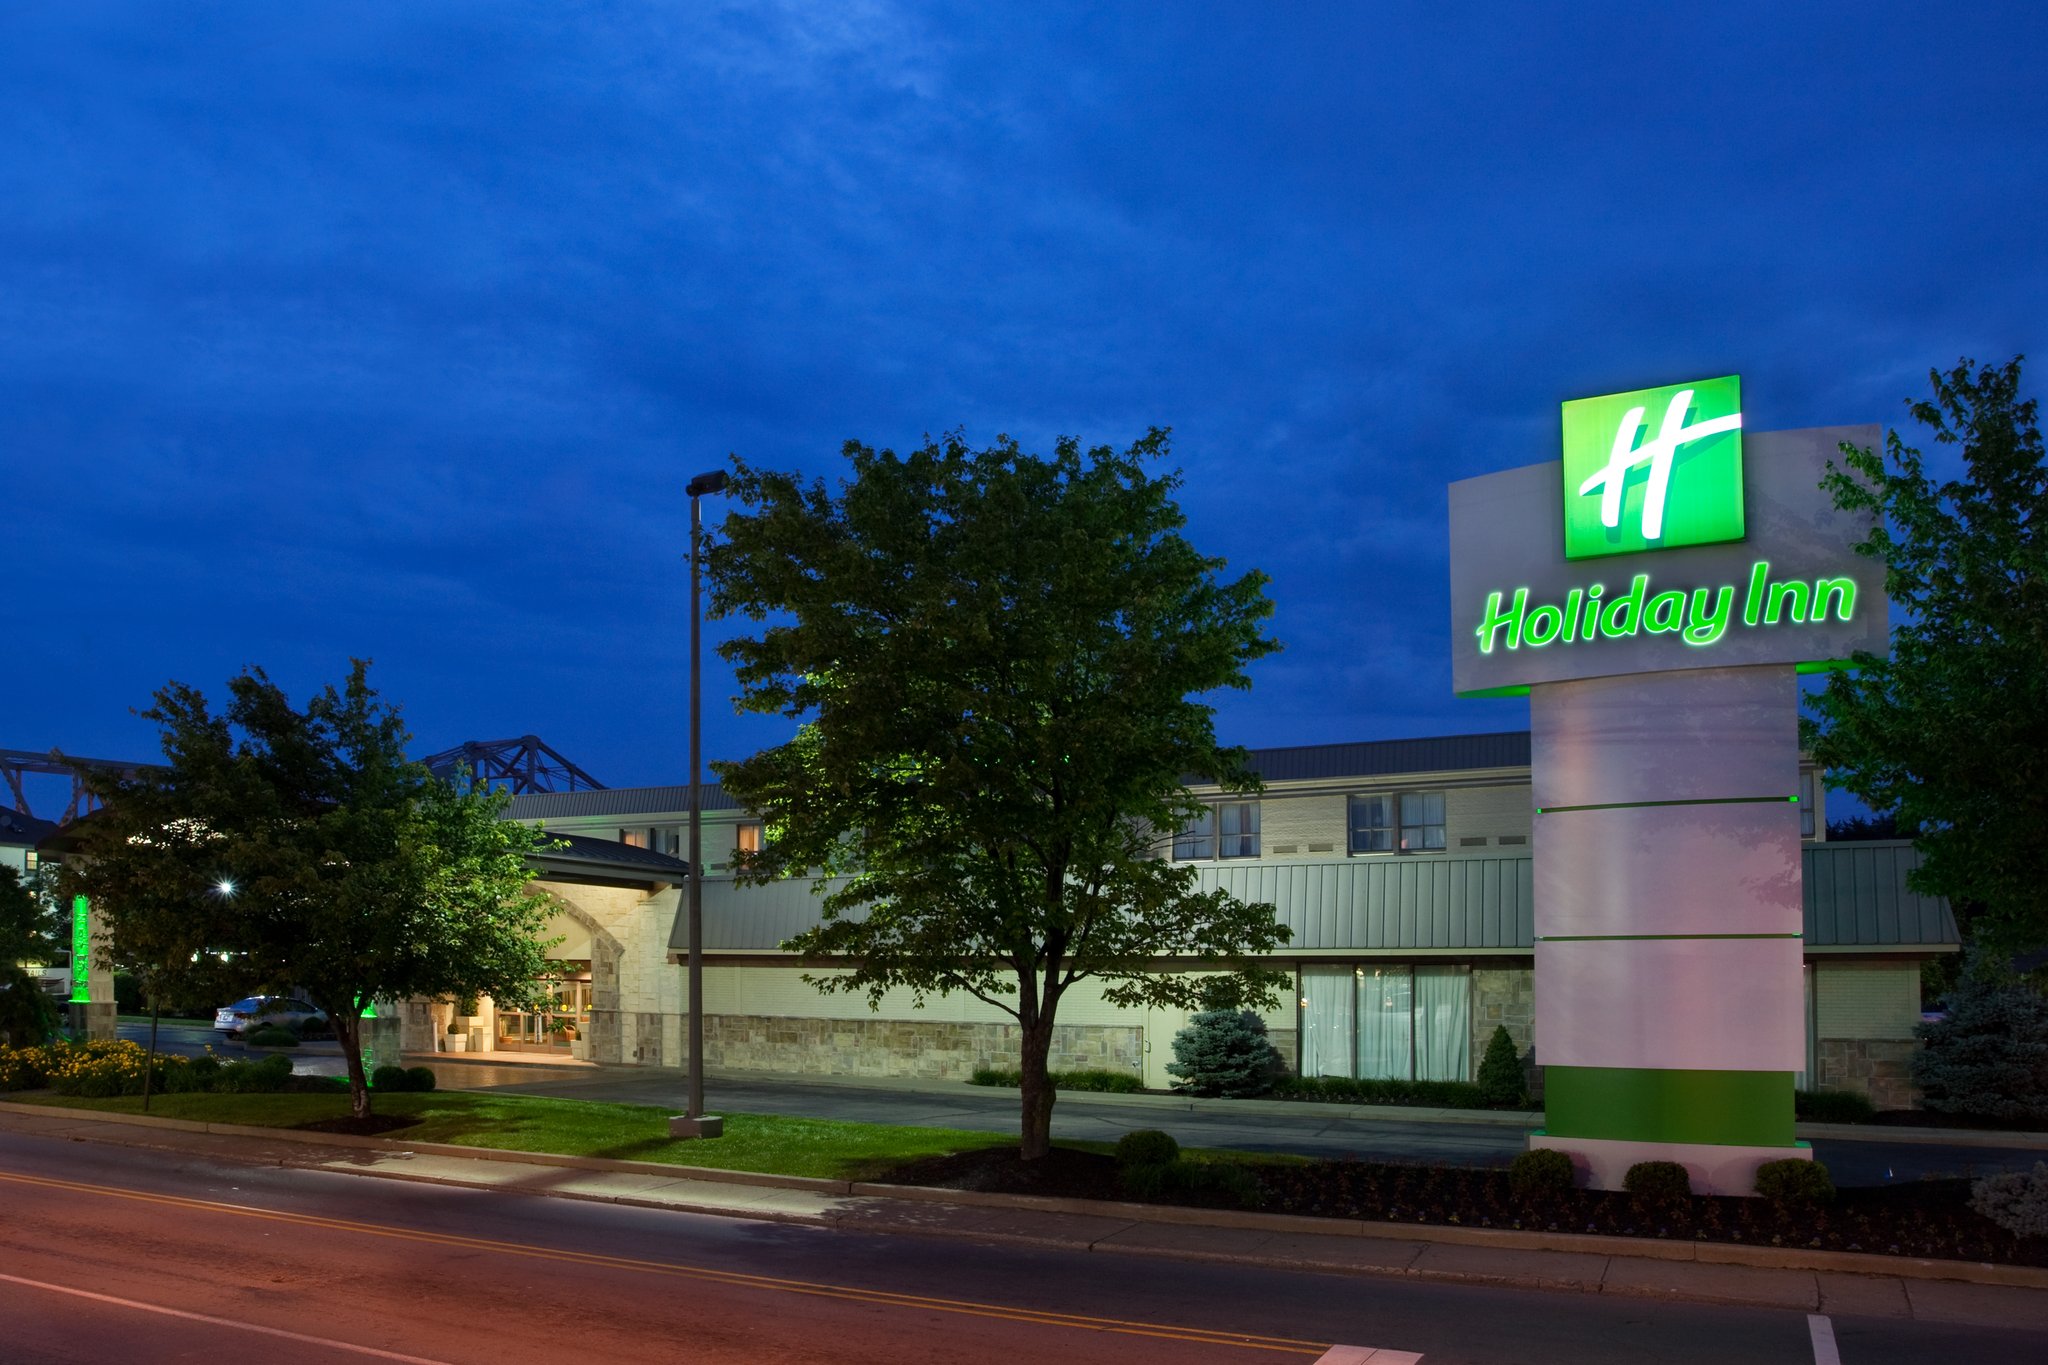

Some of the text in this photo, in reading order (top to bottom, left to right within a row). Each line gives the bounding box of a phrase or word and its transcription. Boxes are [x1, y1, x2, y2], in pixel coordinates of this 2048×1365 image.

[1579, 389, 1743, 540] H
[1476, 561, 1857, 654] Holiday Inn
